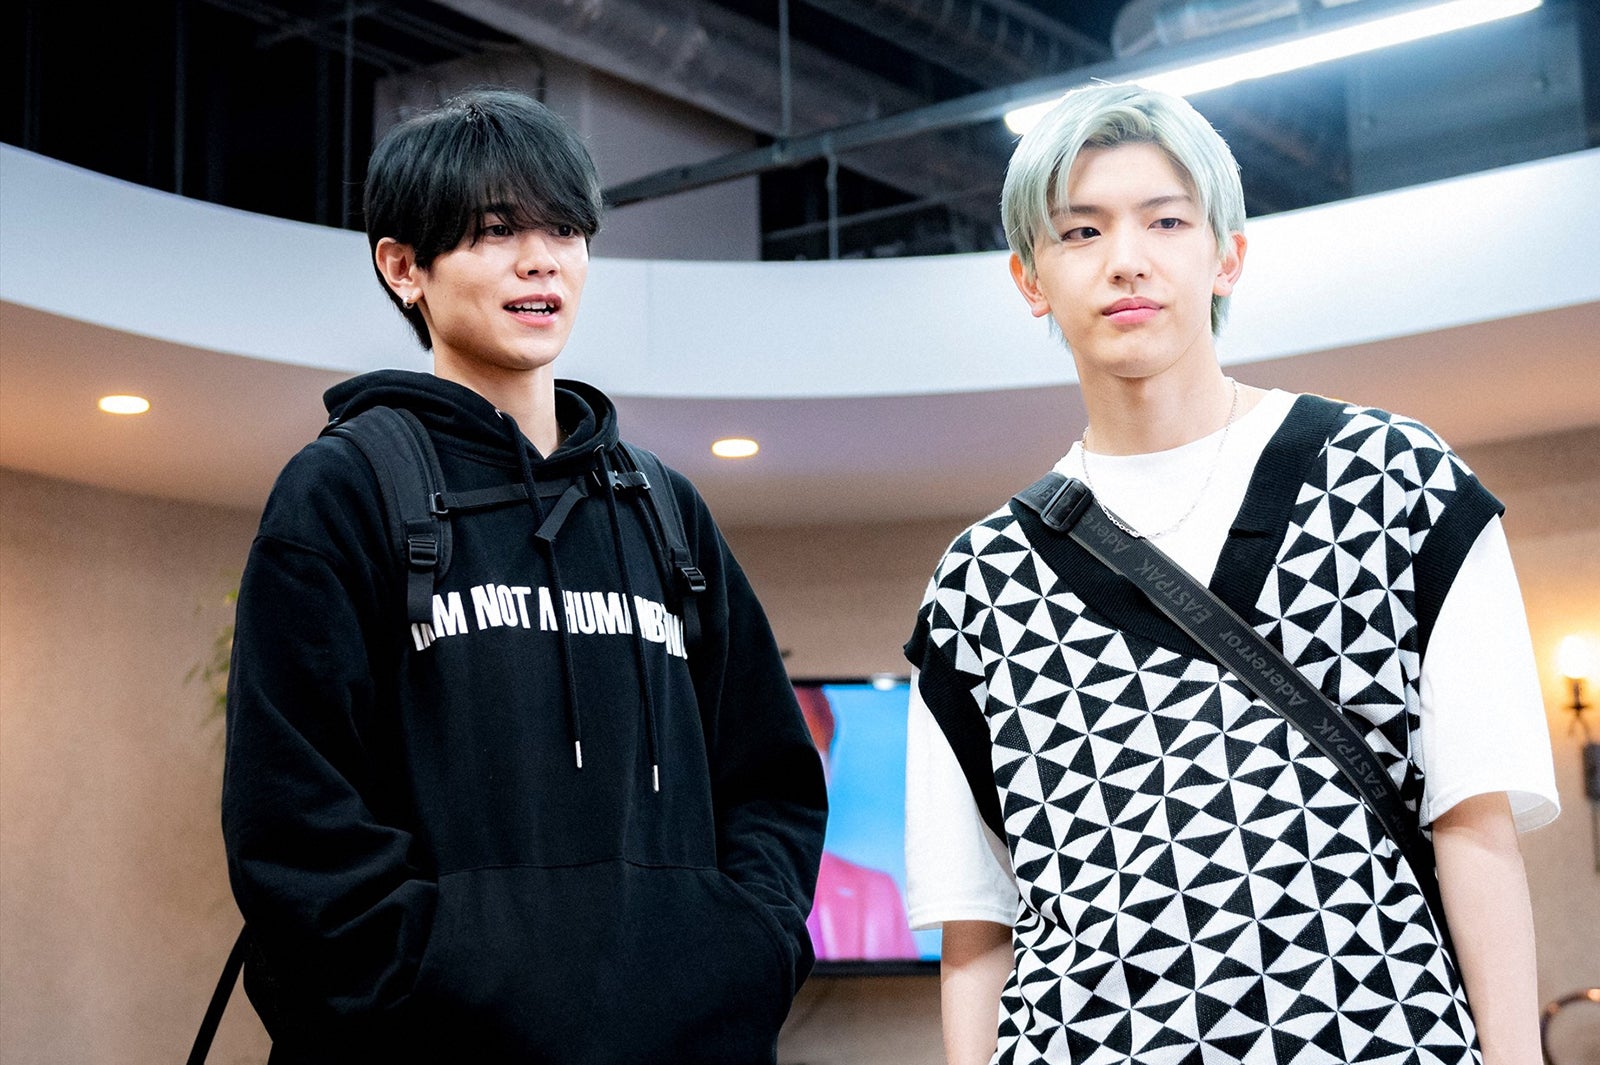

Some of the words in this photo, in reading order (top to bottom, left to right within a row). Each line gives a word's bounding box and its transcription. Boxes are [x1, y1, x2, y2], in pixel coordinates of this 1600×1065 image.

[1080, 512, 1131, 554] Adere
[470, 583, 531, 631] NOT
[539, 587, 559, 631] A
[1134, 558, 1213, 625] EASTPAK
[1218, 630, 1309, 706] Adererror
[1312, 717, 1388, 799] EASTPAK
